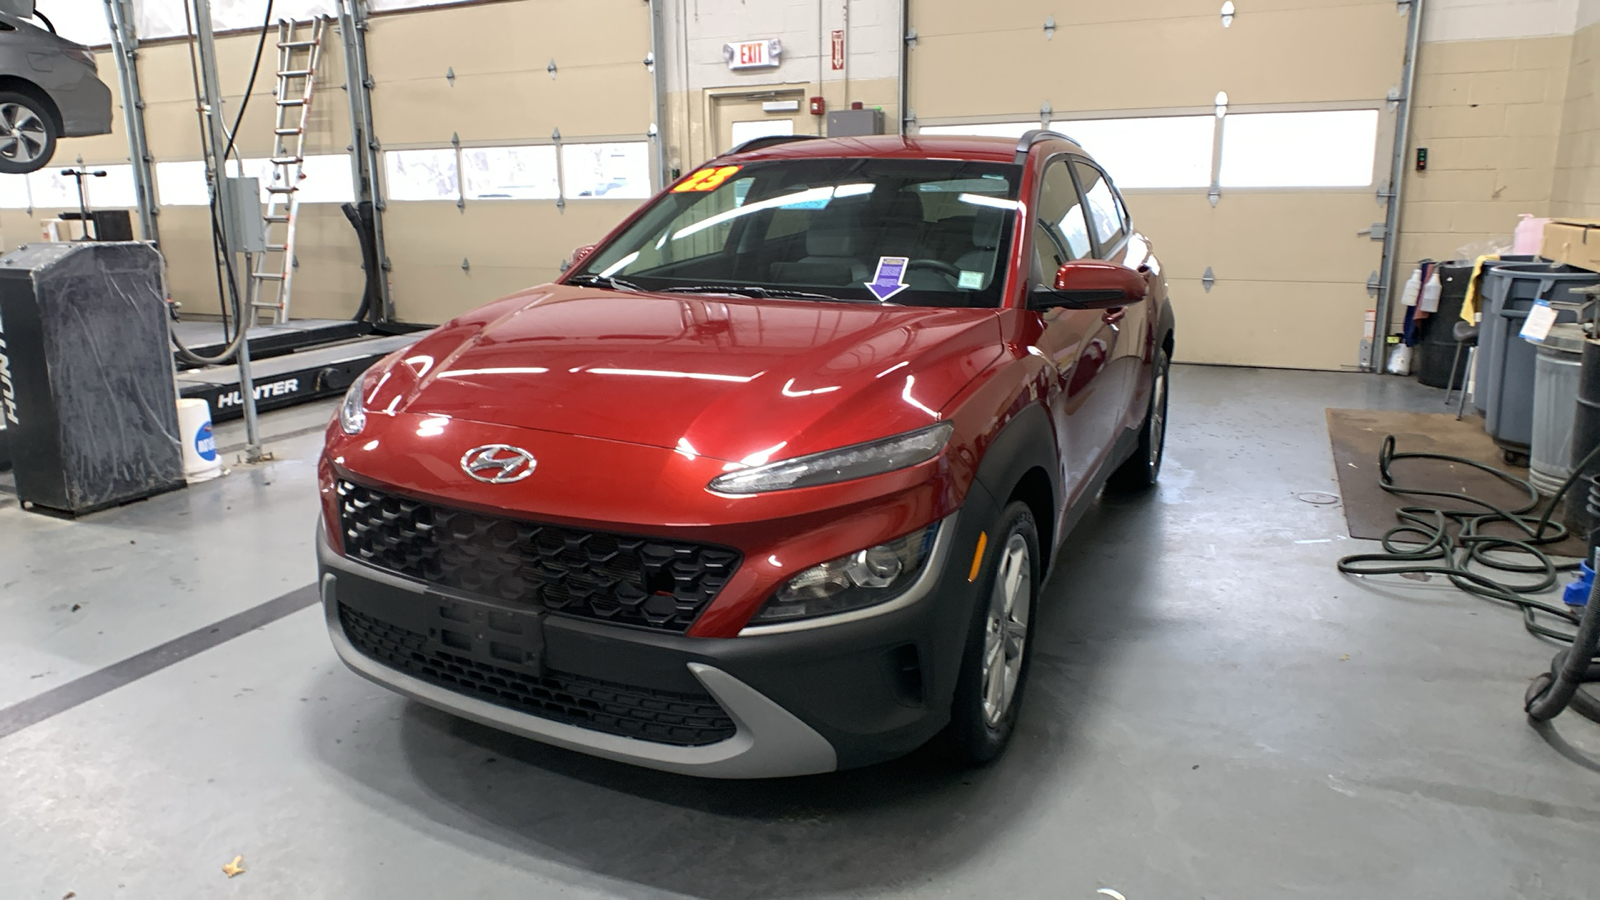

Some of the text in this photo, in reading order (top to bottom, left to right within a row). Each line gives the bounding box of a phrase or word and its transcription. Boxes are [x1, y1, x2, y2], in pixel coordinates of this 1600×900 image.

[740, 43, 763, 65] EXIT
[673, 165, 740, 192] 23
[0, 310, 20, 425] HUN
[217, 378, 299, 409] HUNTER
